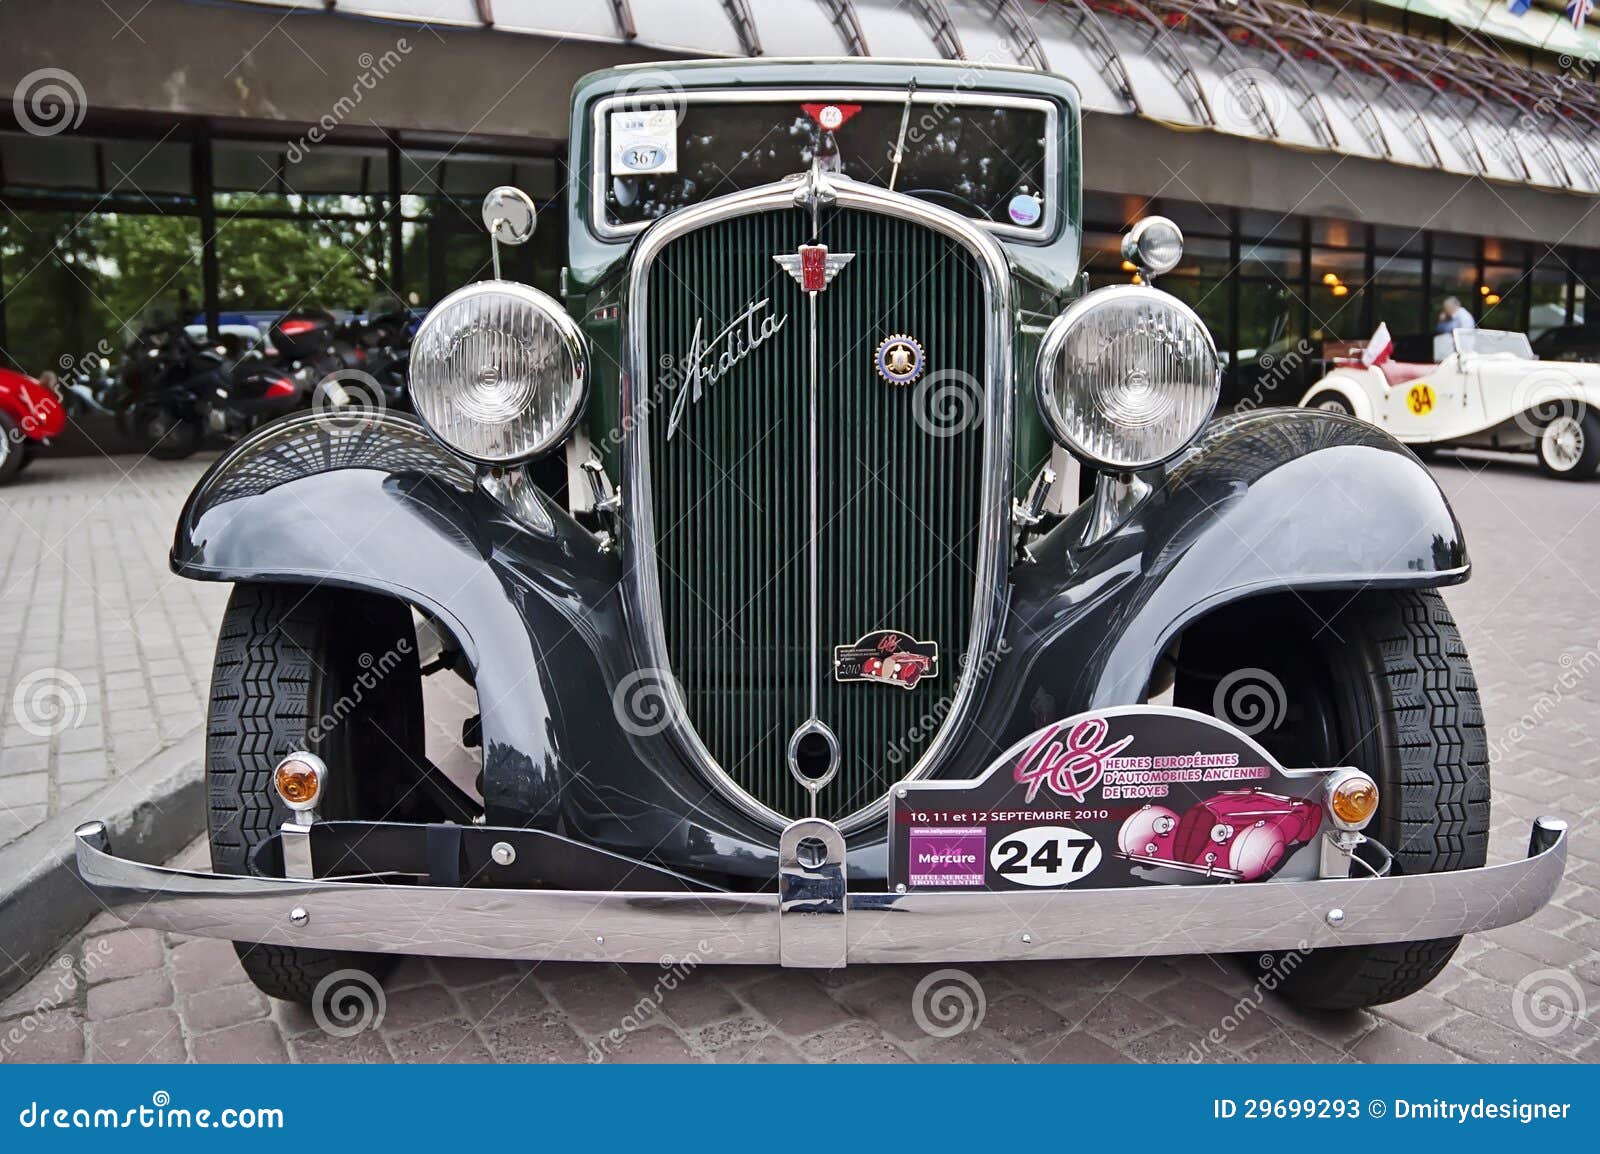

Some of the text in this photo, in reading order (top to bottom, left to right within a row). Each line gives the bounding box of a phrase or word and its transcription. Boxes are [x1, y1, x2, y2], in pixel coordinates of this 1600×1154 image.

[630, 150, 658, 166] 367
[667, 297, 788, 441] Ardita
[1410, 386, 1432, 413] 34
[876, 634, 902, 653] 48
[1013, 718, 1134, 804] 48
[1105, 752, 1239, 770] HEURES EUROPÉENNES
[1103, 784, 1169, 799] DE TROYES
[910, 810, 1109, 823] 10, 11 et 12 SEPTEMBRE 2010
[918, 853, 977, 863] Mercure
[996, 839, 1096, 874] 247
